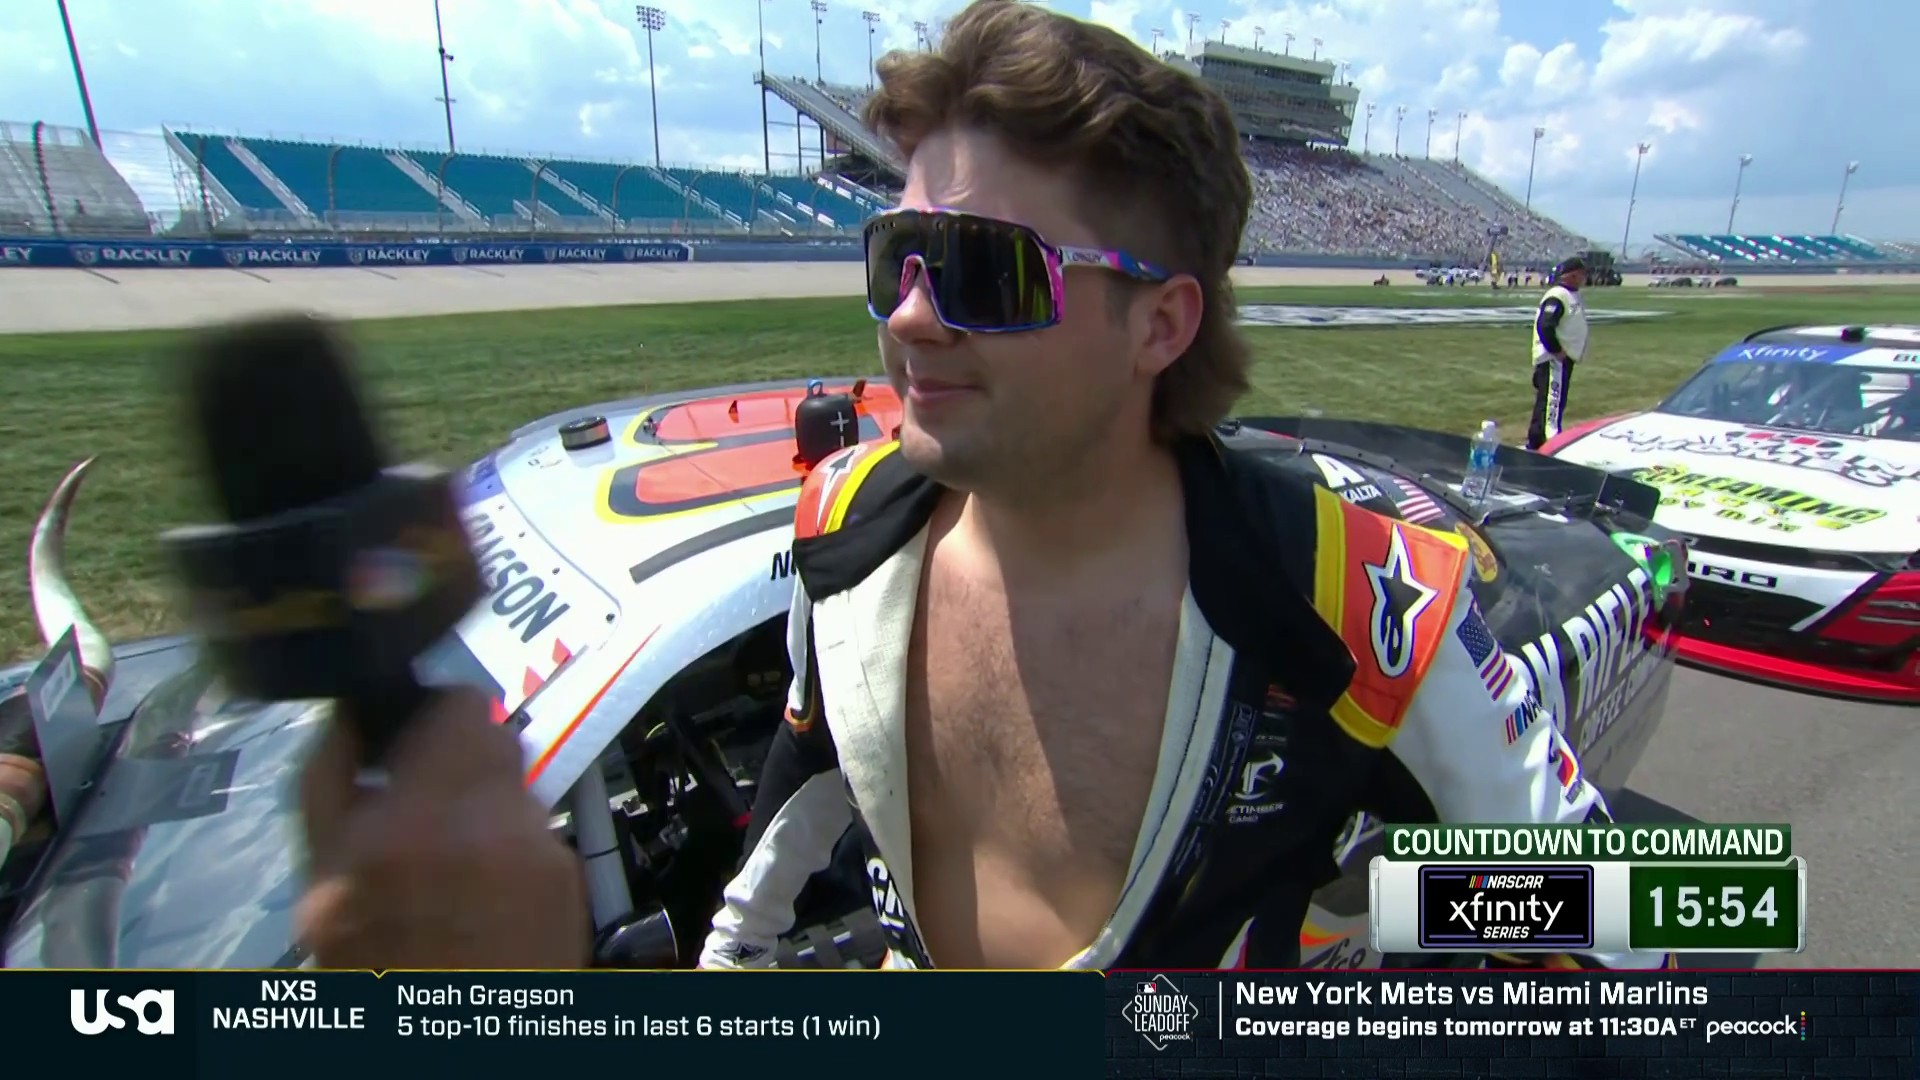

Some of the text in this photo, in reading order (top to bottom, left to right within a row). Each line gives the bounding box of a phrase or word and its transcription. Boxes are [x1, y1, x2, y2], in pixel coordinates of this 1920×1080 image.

[102, 249, 192, 262] RACKLEY
[248, 250, 321, 262] RACKLEY
[367, 249, 430, 261] RACKLEY
[469, 248, 524, 260] RACKLEY
[558, 248, 606, 259] RACKLEY
[636, 247, 680, 258] RACKLEY
